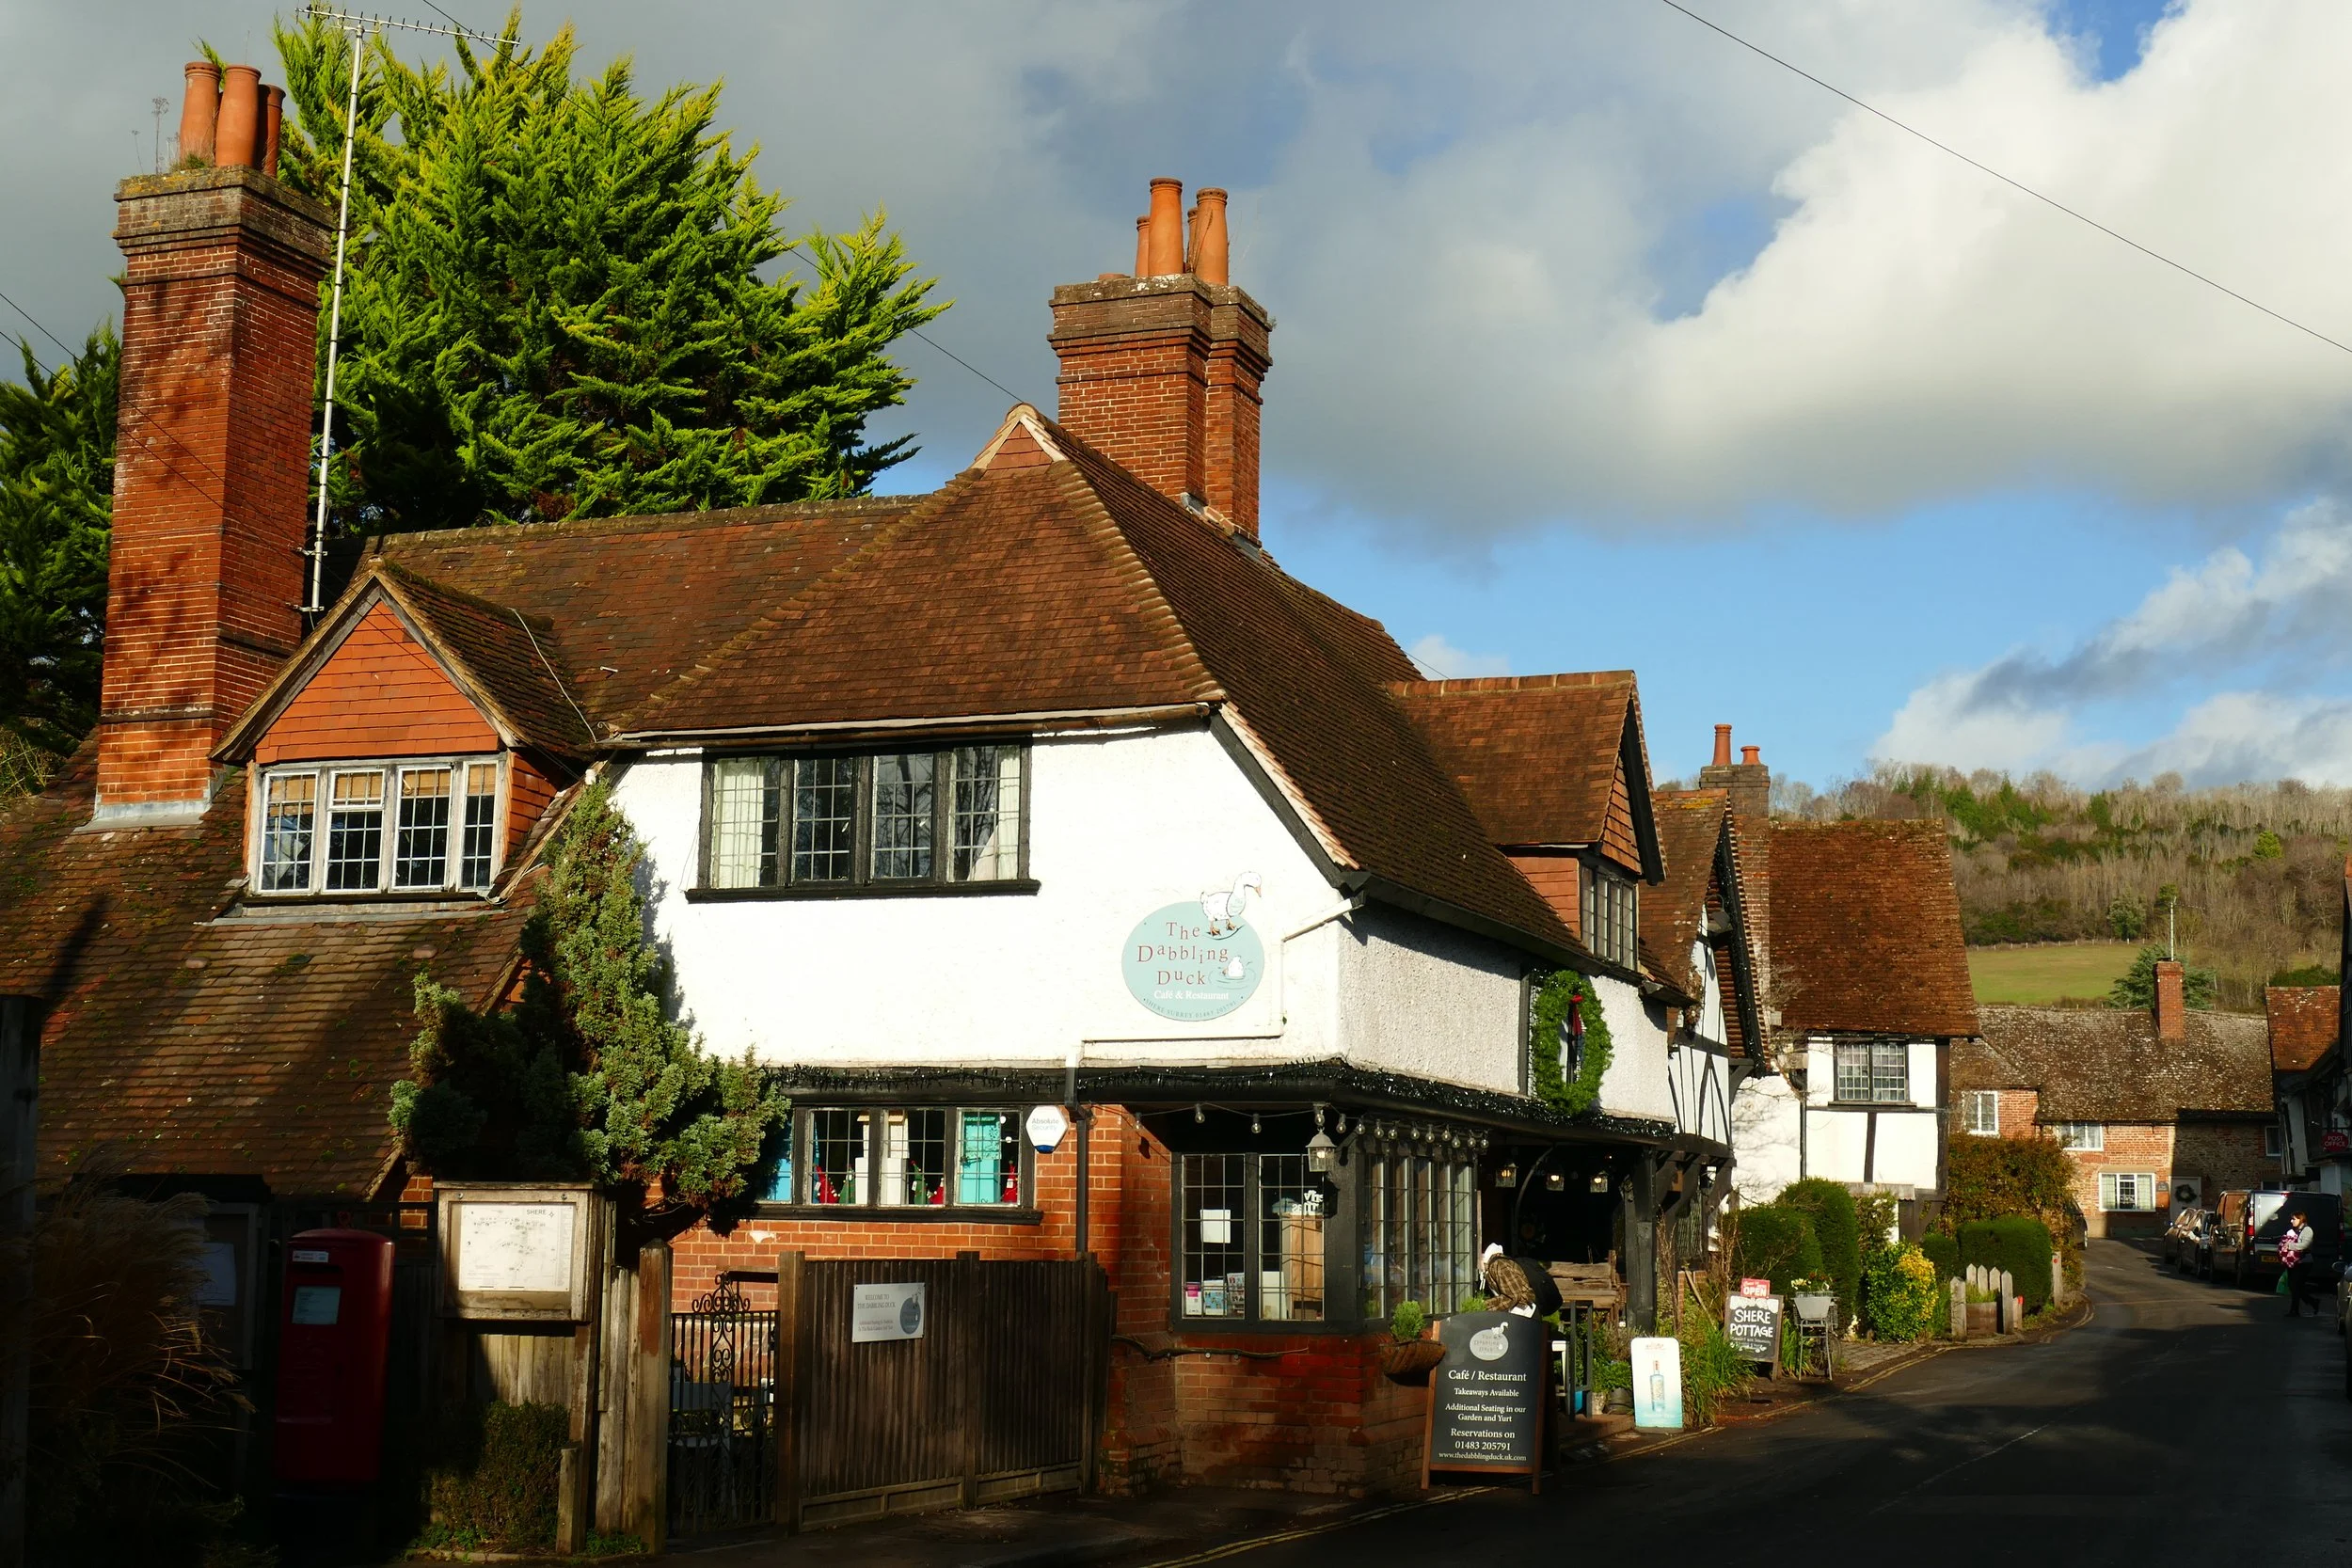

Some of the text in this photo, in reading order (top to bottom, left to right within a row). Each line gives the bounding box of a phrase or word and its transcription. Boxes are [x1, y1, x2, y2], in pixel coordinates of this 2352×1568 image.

[1166, 922, 1200, 940] The
[1136, 944, 1229, 963] Dabbling
[1156, 971, 1205, 985] Duck
[1153, 990, 1173, 999] Café
[1185, 990, 1229, 1000] Restaurant
[1743, 1287, 1767, 1297] OPEN
[1734, 1309, 1771, 1323] SHERE
[1730, 1323, 1773, 1338] POTTAGE
[1448, 1370, 1527, 1382] Café / Restaurant
[1454, 1387, 1488, 1398] Takeaways
[1445, 1403, 1480, 1412] Additional
[1481, 1404, 1505, 1414] Seating
[1451, 1428, 1502, 1438] Reservations
[1454, 1441, 1511, 1451] 01483 205791
[1438, 1452, 1527, 1461] www.thedabblingduck.uk.com
